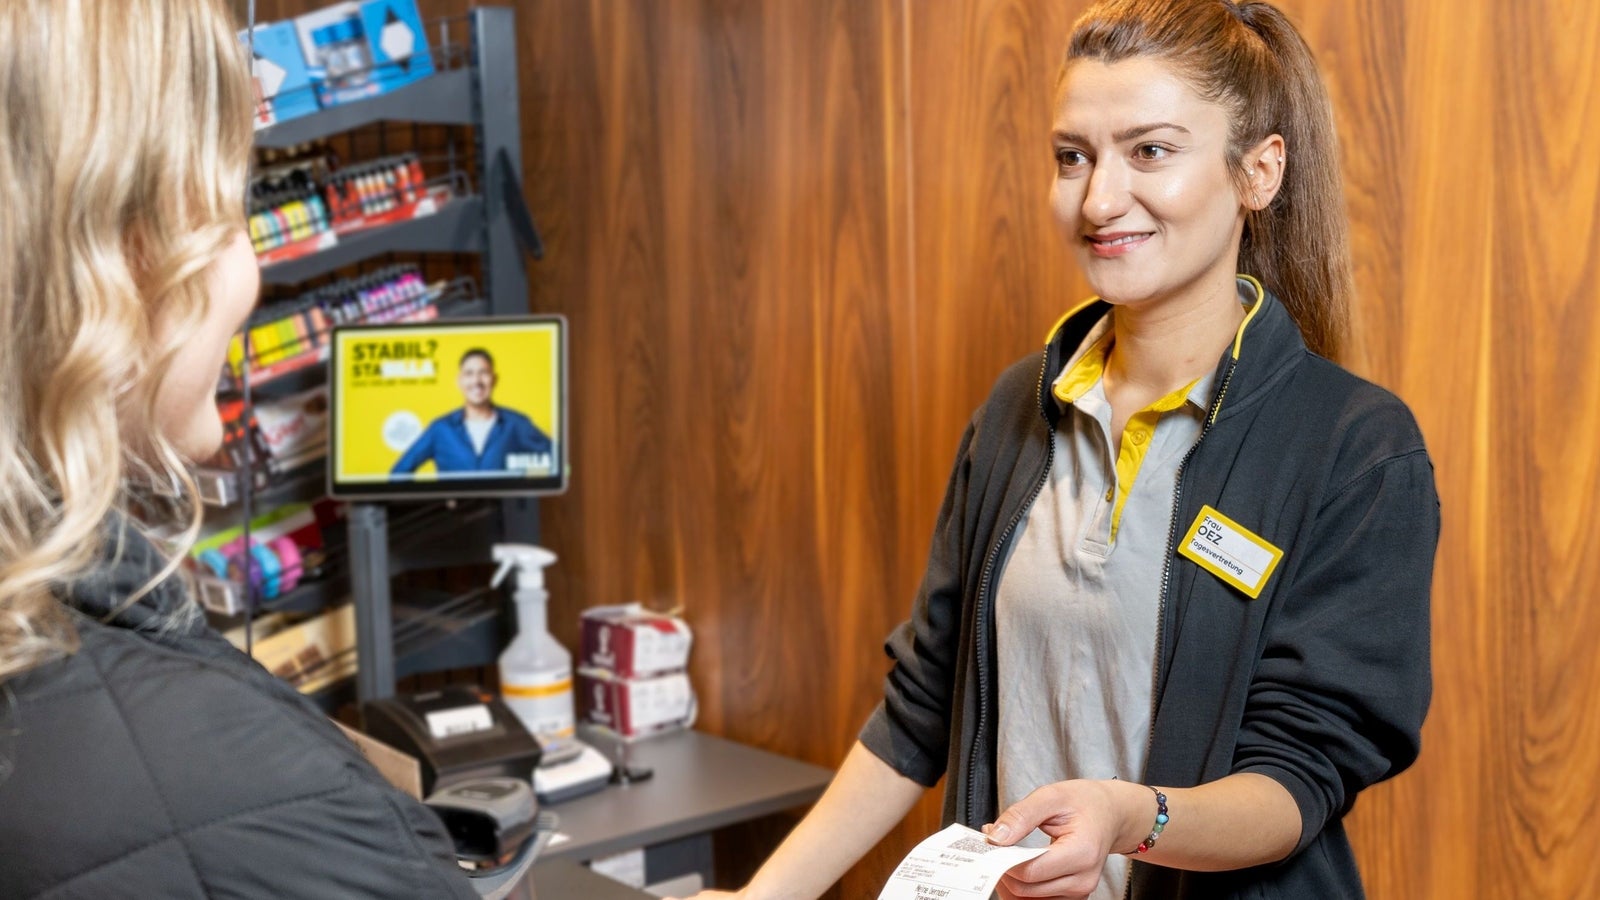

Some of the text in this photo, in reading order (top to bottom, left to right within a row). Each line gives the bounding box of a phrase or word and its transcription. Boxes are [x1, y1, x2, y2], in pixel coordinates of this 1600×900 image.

[352, 340, 438, 361] STABIL?
[506, 453, 551, 470] BILLA
[1203, 516, 1222, 532] Frau
[1197, 525, 1223, 546] OEZ
[1190, 538, 1244, 575] Tagesvertretung
